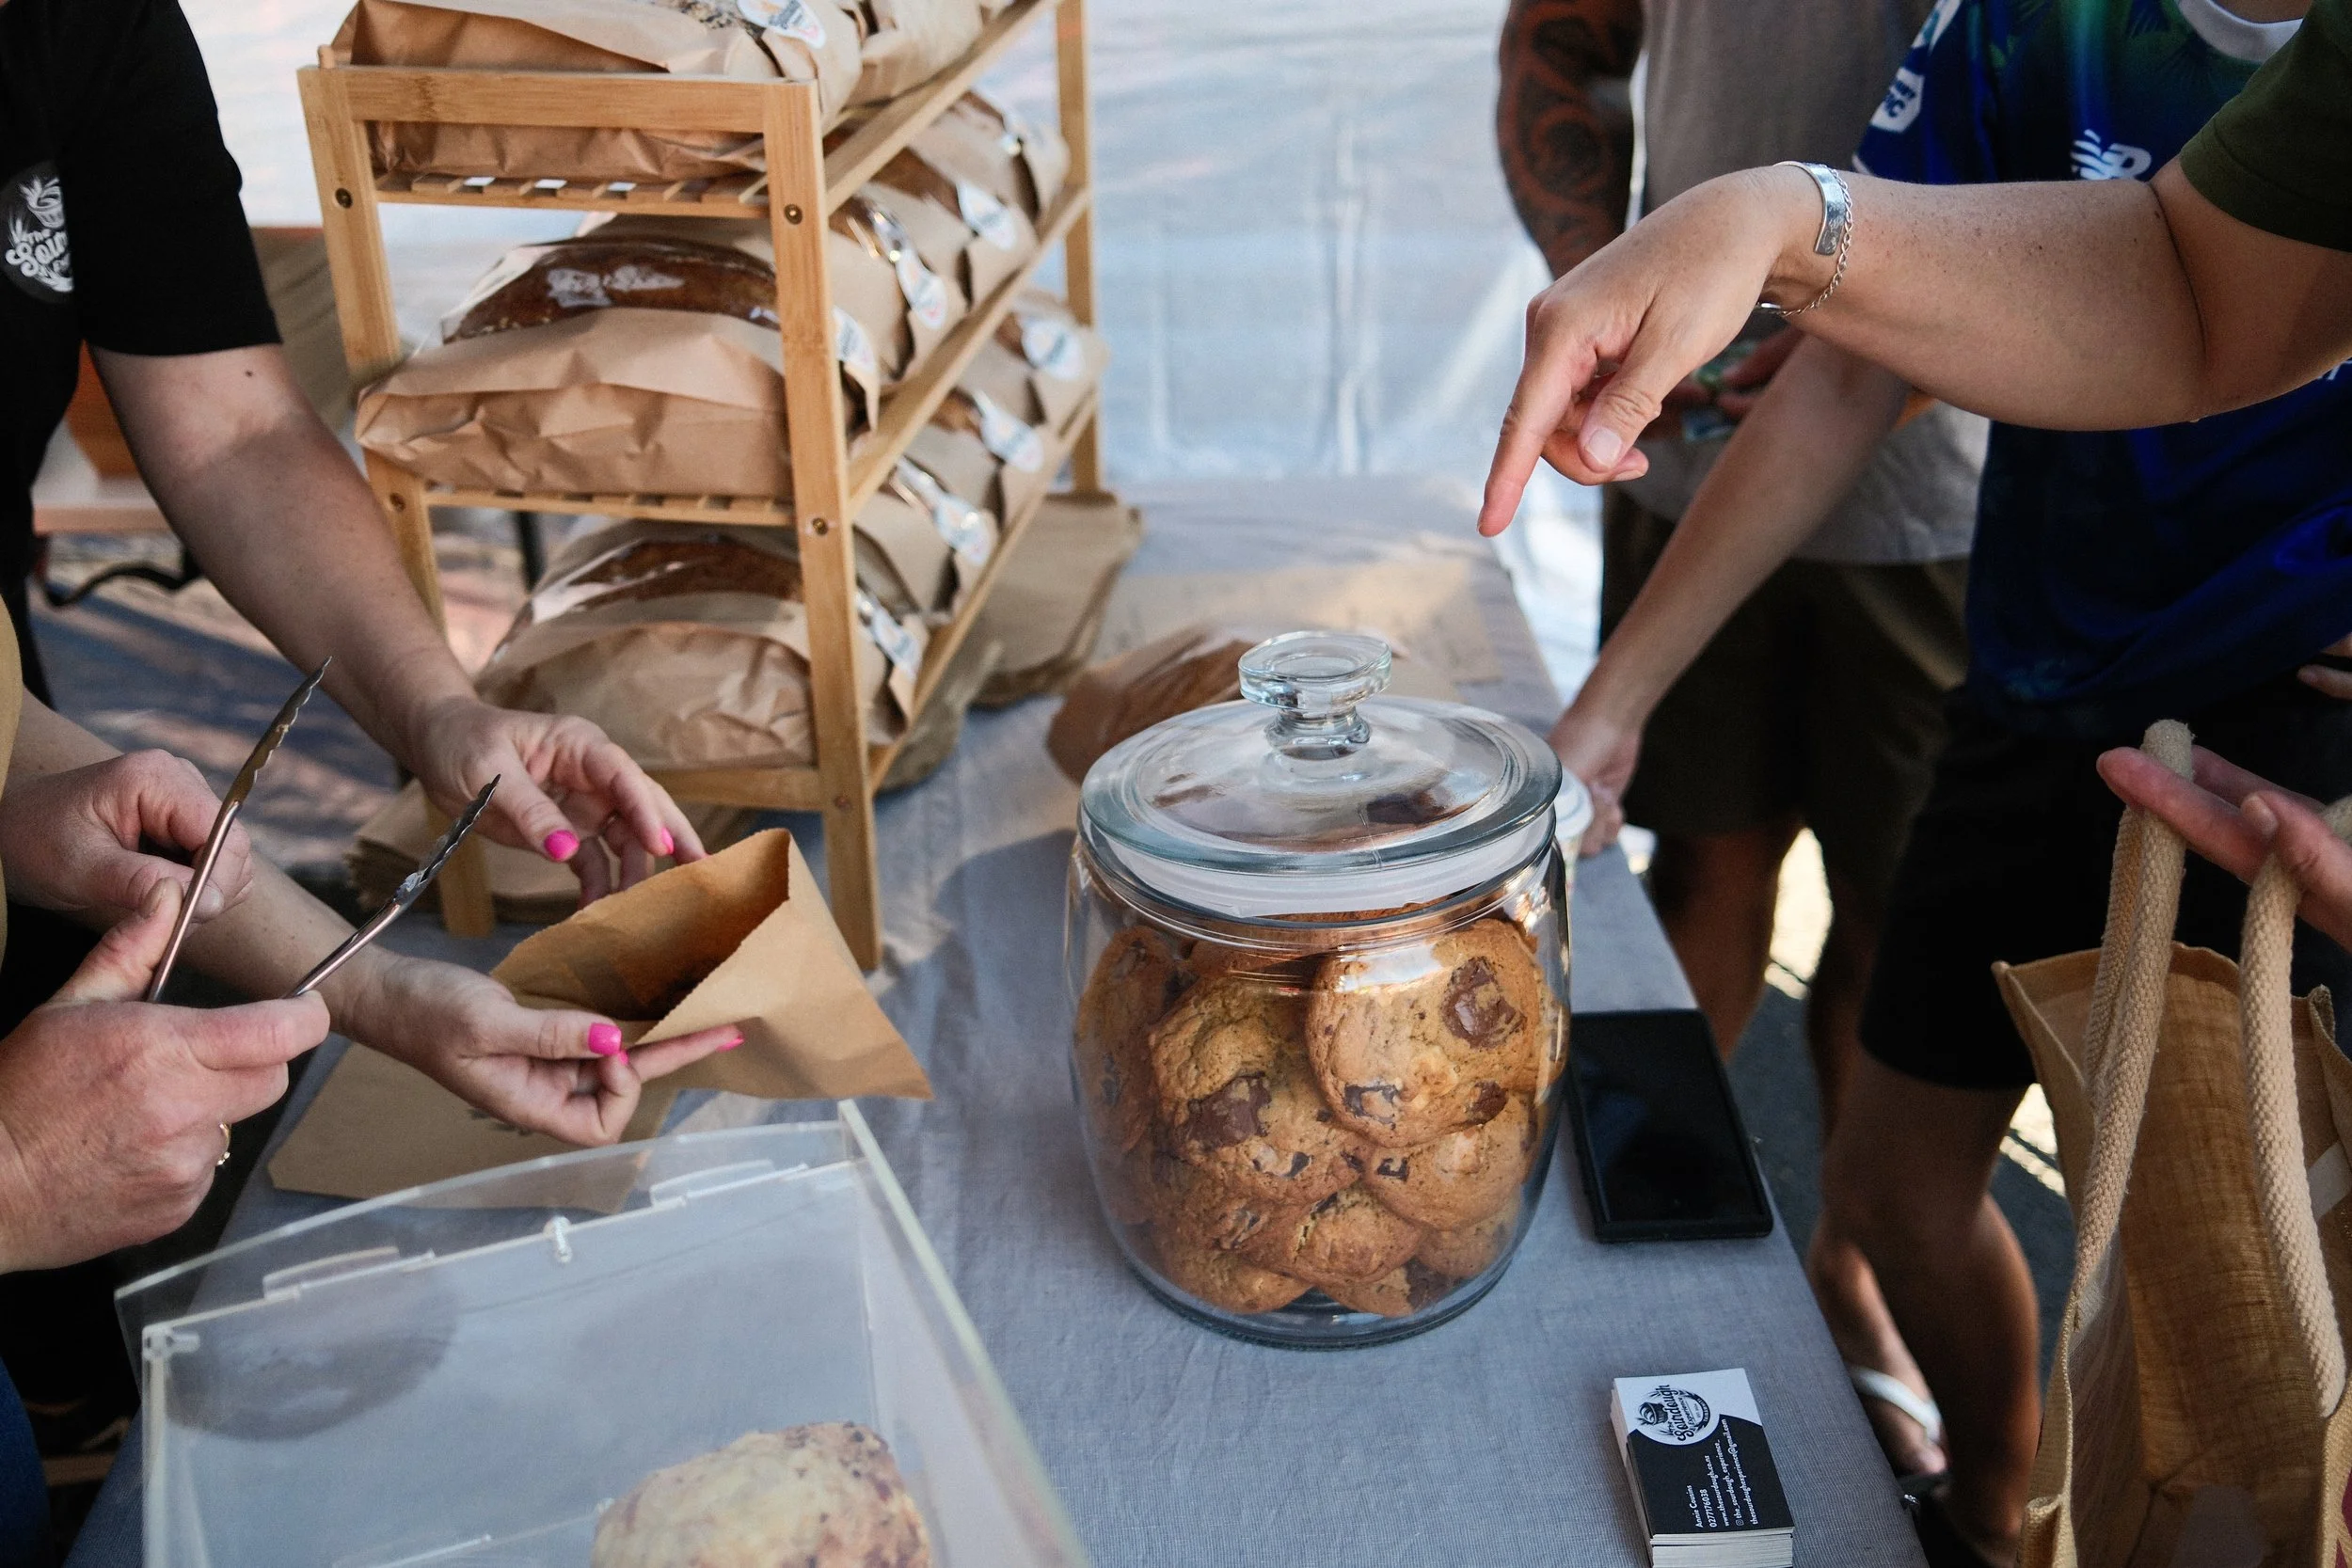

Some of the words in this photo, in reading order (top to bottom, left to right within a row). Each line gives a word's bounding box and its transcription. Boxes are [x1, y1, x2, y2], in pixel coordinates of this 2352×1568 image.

[1655, 1384, 1694, 1442] Sourdough
[1677, 1397, 1695, 1425] Experience
[1704, 1455, 1729, 1527] www.thesourdough.co.nz
[1721, 1418, 1758, 1525] thesourdoughexperience@gmail.com
[1686, 1484, 1697, 1508] Cousins
[1699, 1488, 1717, 1528] 0277176038
[1692, 1509, 1703, 1528] Annie
